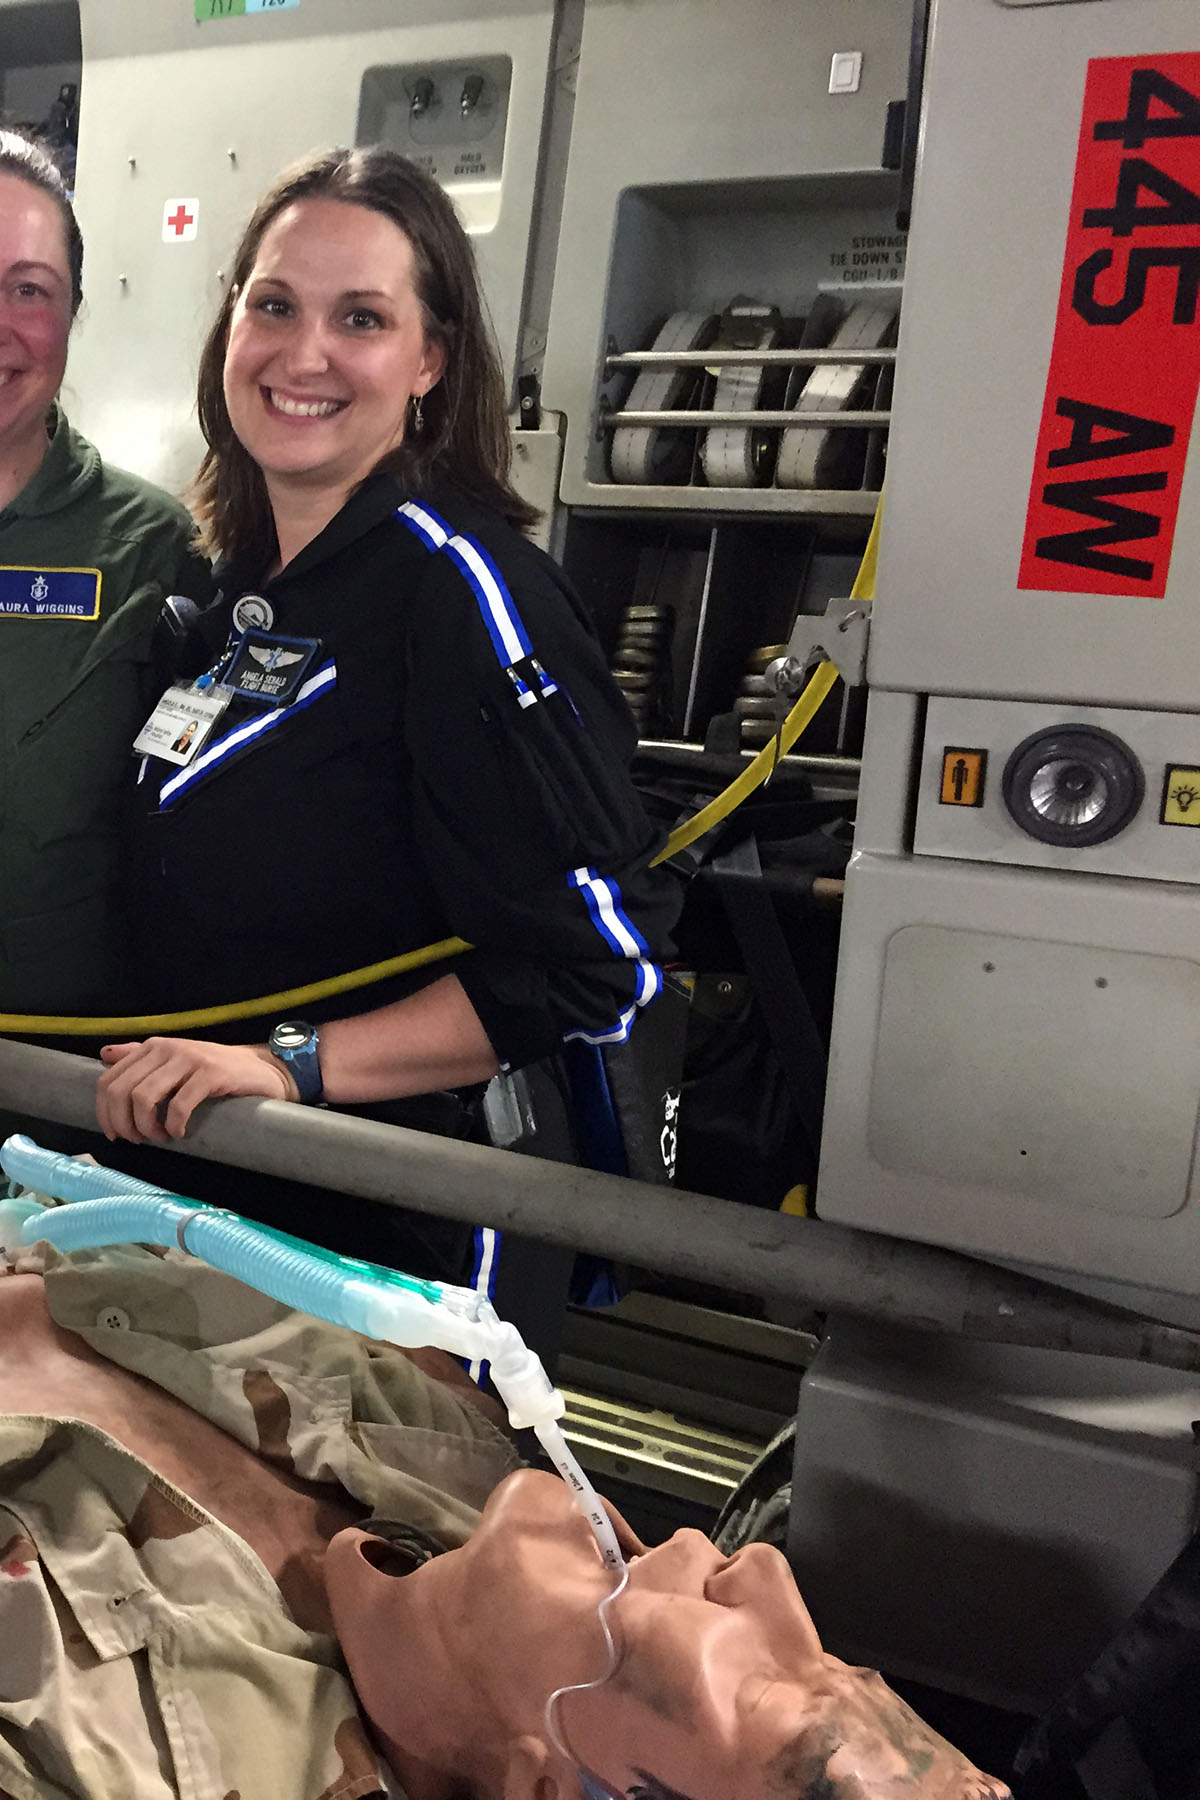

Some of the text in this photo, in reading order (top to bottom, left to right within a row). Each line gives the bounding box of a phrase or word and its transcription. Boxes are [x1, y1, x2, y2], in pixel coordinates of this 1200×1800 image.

[829, 253, 846, 266] TIE
[852, 252, 889, 265] DOWN
[1034, 69, 1200, 581] 445 AW
[35, 603, 85, 614] WIGGINS
[240, 670, 264, 683] ANGELA
[240, 680, 260, 692] FLIGHT
